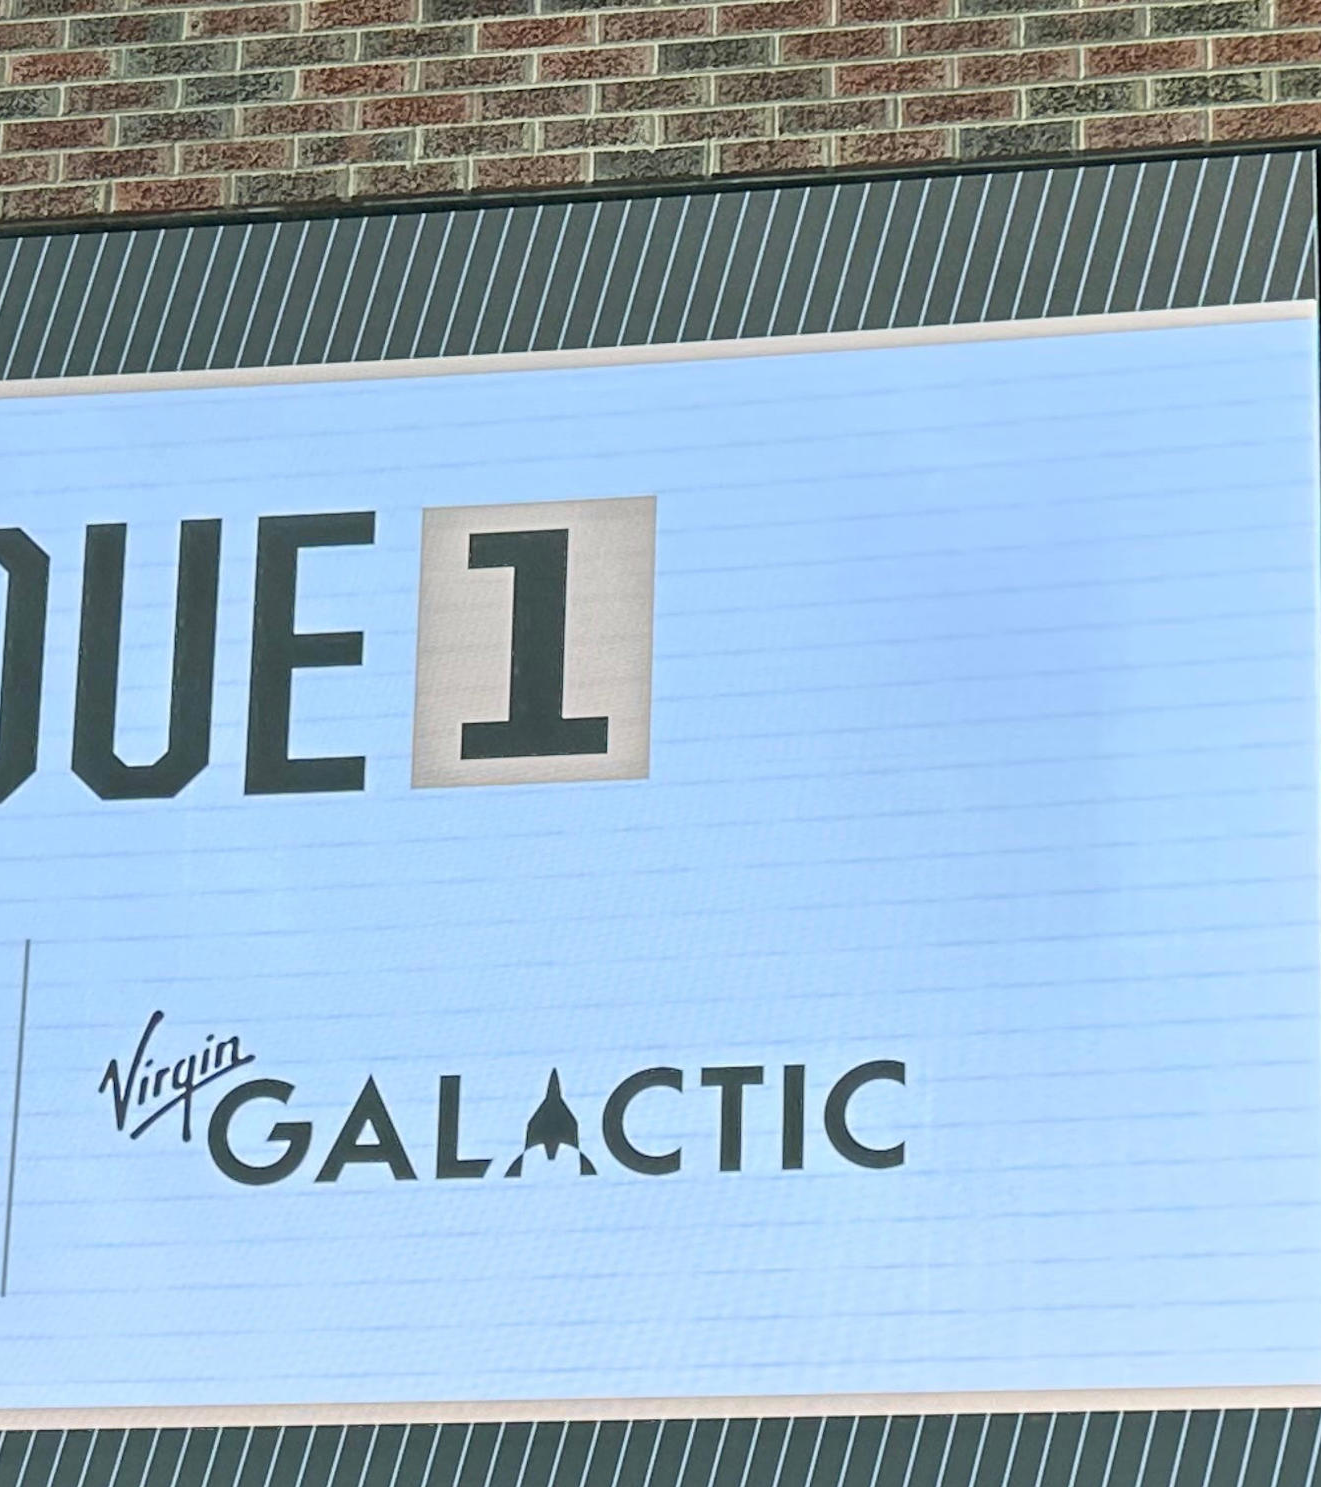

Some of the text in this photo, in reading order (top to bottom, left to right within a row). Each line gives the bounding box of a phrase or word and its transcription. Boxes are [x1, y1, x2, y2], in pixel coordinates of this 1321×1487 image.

[460, 527, 609, 760] 1
[98, 1010, 255, 1142] Virgin
[207, 1060, 906, 1187] GALACTIC
